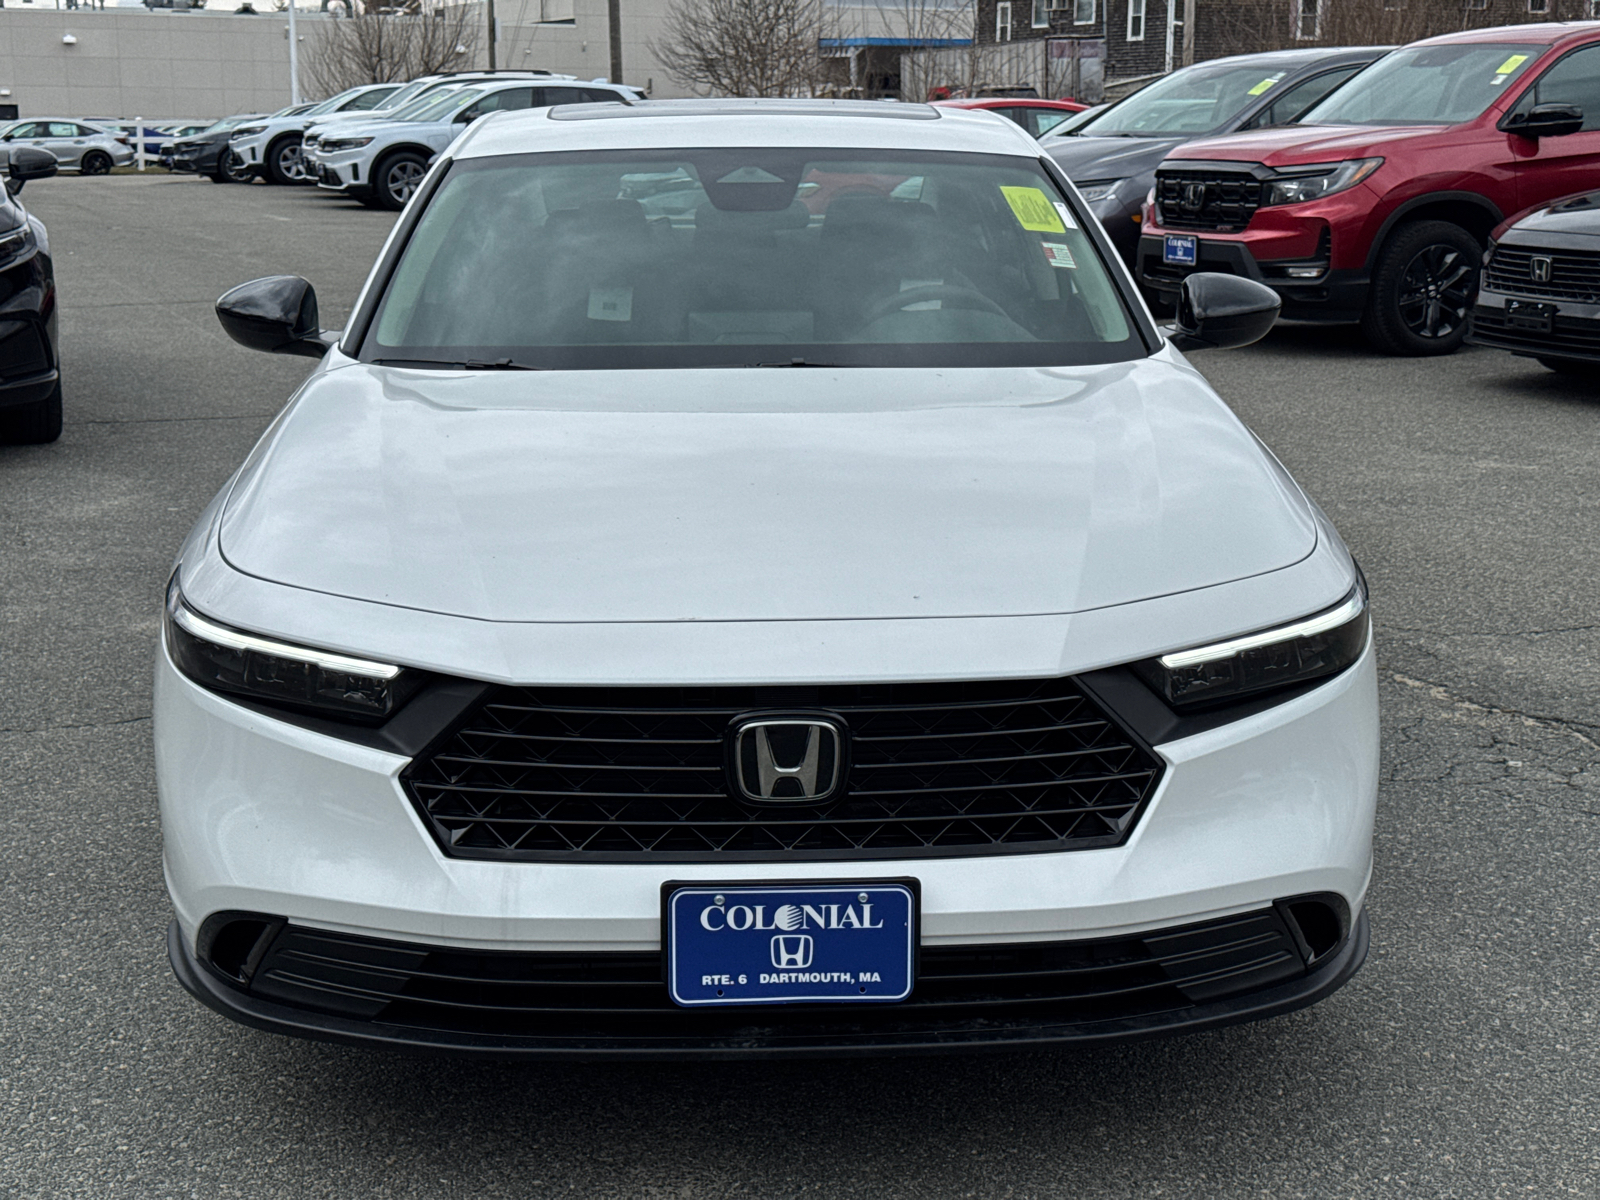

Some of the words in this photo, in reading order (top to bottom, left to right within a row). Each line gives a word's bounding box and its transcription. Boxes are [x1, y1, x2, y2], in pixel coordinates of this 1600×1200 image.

[700, 903, 884, 931] COLONIAL
[702, 975, 735, 986] RTE.
[738, 974, 748, 985] 6
[759, 972, 856, 985] DARTMOUTH,
[859, 972, 882, 983] MA
